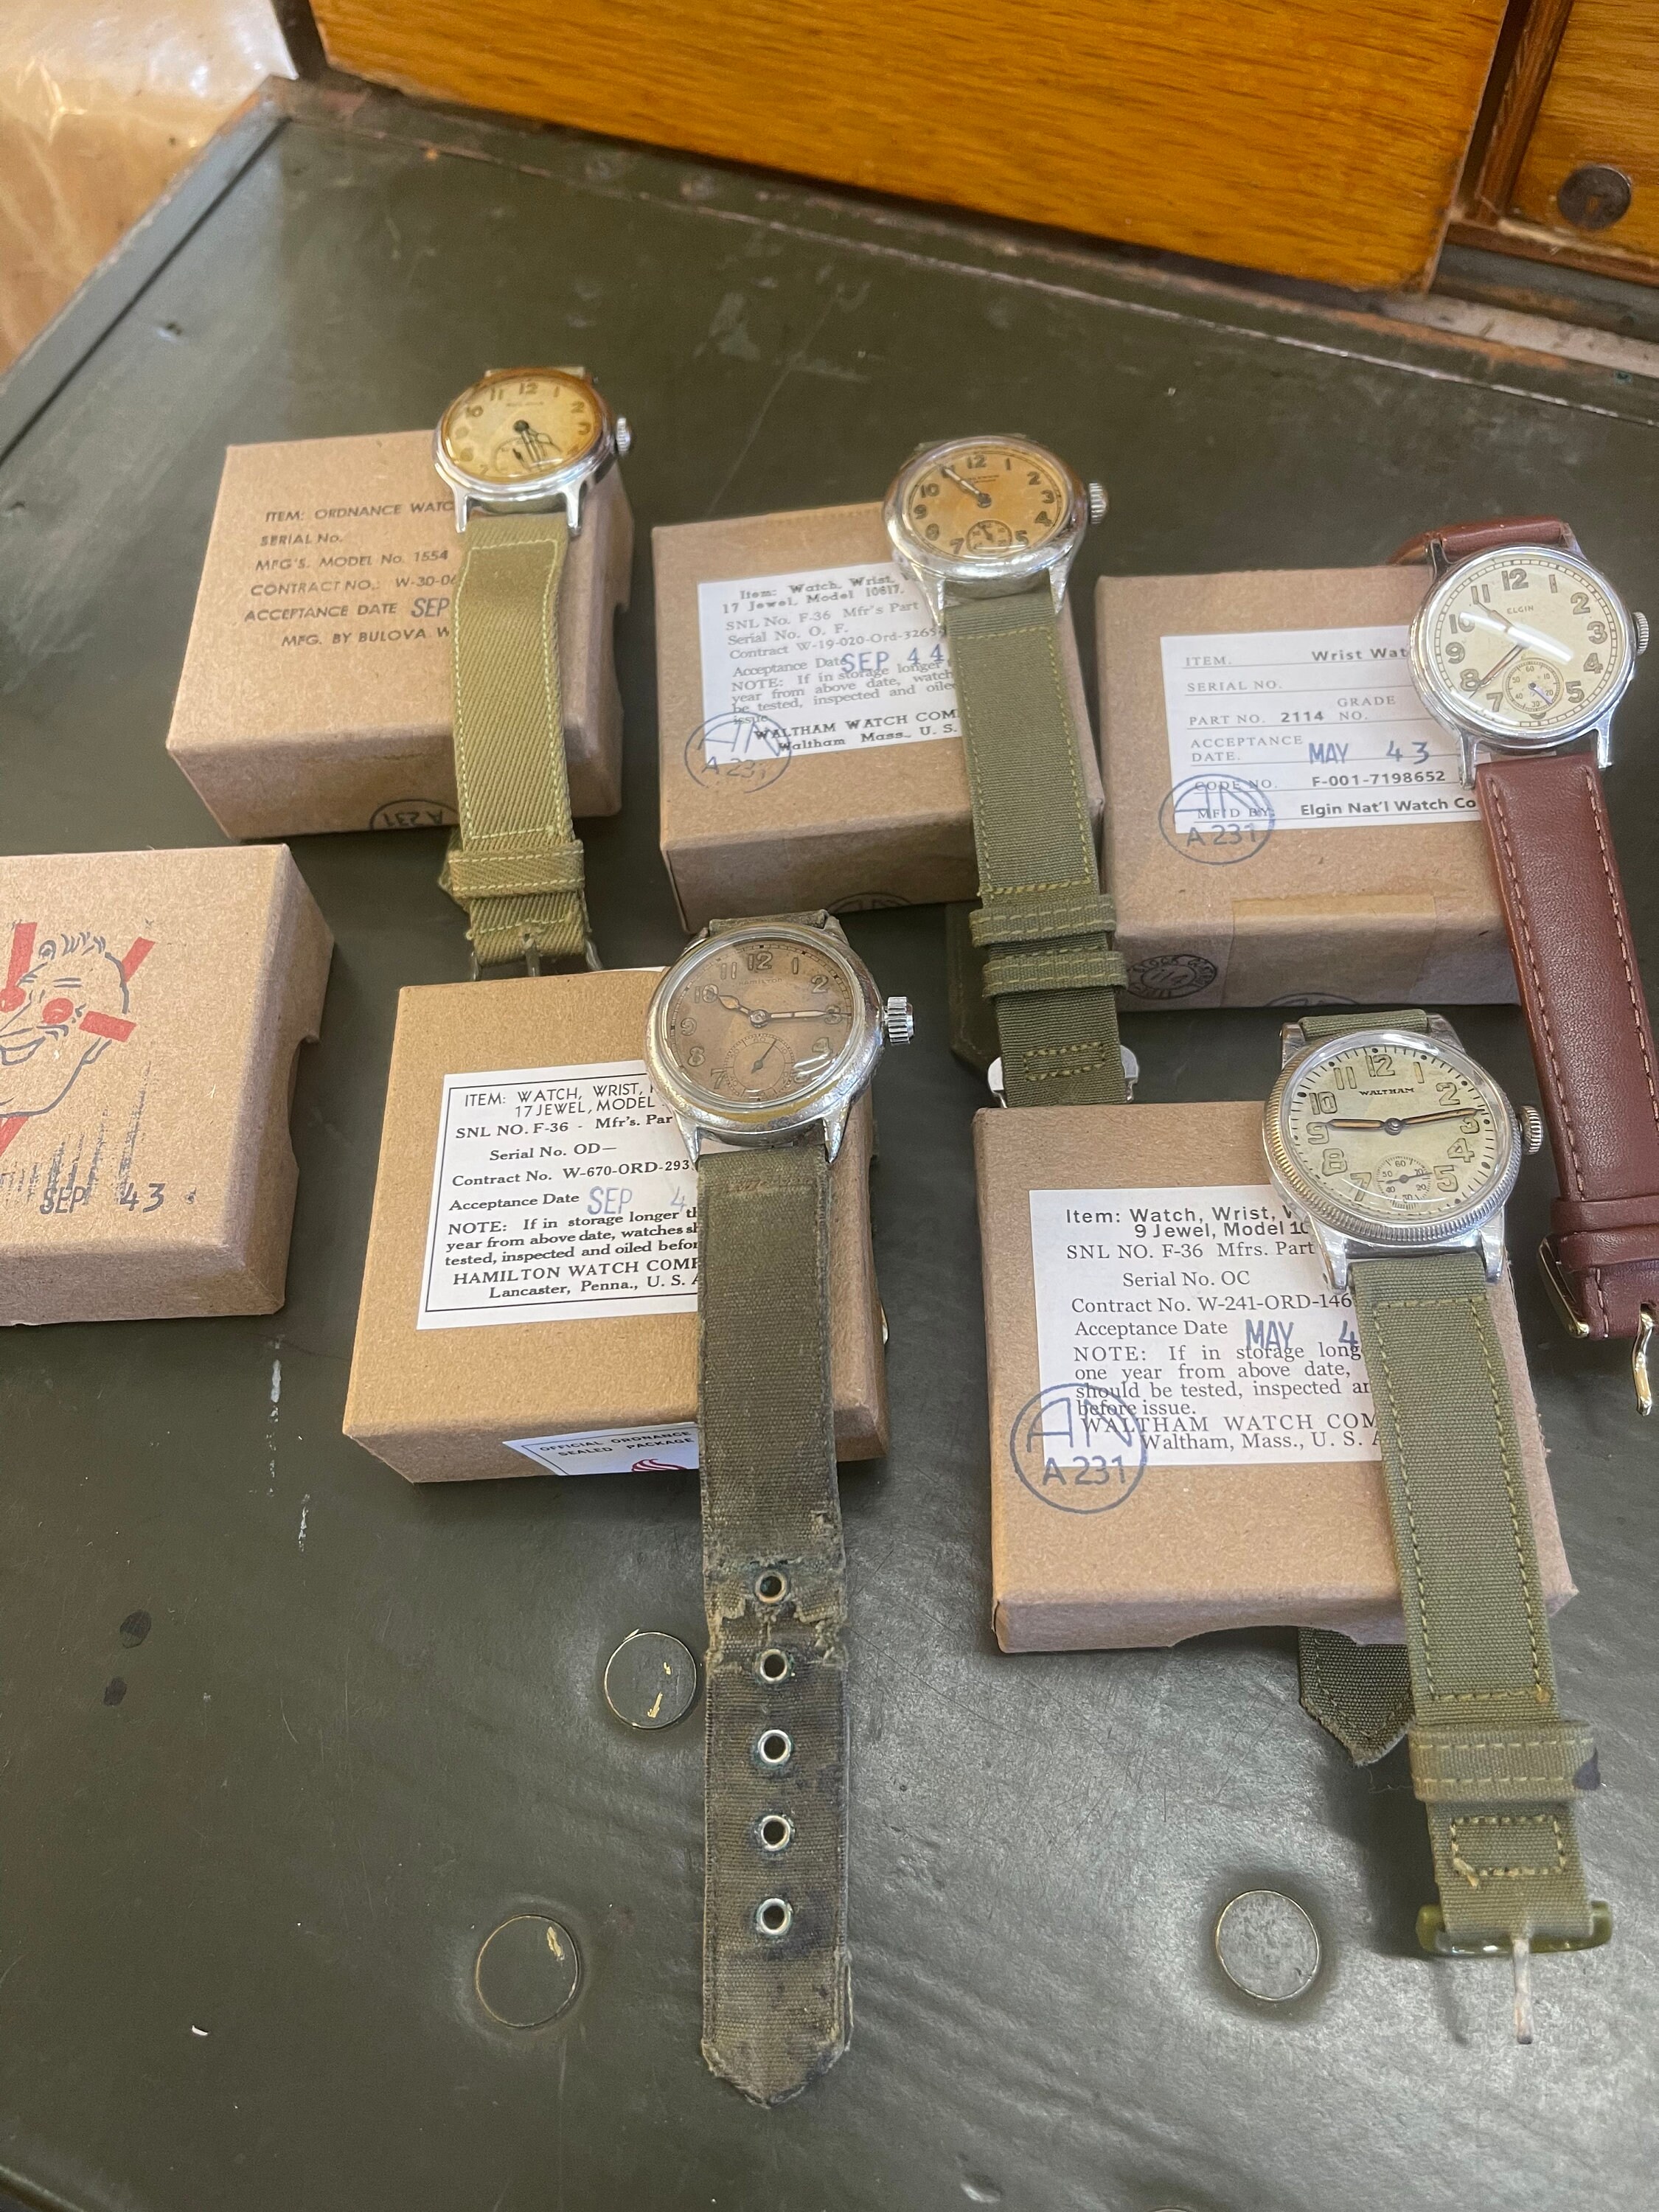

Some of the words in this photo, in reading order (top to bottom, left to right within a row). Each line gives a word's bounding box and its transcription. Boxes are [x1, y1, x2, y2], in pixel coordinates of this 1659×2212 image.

[315, 504, 402, 520] ORDNANCE
[260, 534, 311, 546] SERIAL
[319, 555, 372, 568] MODEL
[414, 550, 448, 561] 1554
[251, 581, 339, 597] CONTRACT
[1501, 568, 1529, 591] 12
[807, 590, 853, 603] Model
[1470, 583, 1490, 605] 11
[1571, 592, 1590, 615] 2
[244, 605, 348, 622] ACCEPTANCE
[358, 602, 397, 616] DATE
[411, 597, 450, 618] SEP
[726, 619, 759, 631] SNL
[799, 611, 831, 623] F-36
[843, 605, 884, 619] Mfr's
[890, 601, 919, 613] Part
[1507, 605, 1534, 614] ELGIN
[282, 634, 322, 647] MFG.
[332, 633, 352, 644] BY
[358, 629, 426, 642] BULOVA
[728, 634, 767, 646] Serial
[774, 630, 801, 641] No.
[1587, 621, 1608, 644] 3
[729, 645, 789, 660] Contract
[1186, 655, 1231, 667] ITEM.
[1312, 650, 1363, 661] Wrist
[1445, 641, 1465, 664] 9
[732, 660, 808, 678] Acceptance
[841, 650, 890, 673] SEP
[1584, 653, 1603, 674] 4
[731, 678, 783, 692] NOTE:
[838, 666, 888, 681] storage
[897, 661, 941, 675] longer
[1187, 681, 1247, 692] SERIAL
[1254, 680, 1283, 689] NO.
[1460, 669, 1479, 692] 8
[731, 693, 762, 705] year
[772, 686, 804, 699] from
[815, 681, 855, 695] above
[732, 703, 750, 714] be
[758, 698, 803, 712] tested,
[813, 689, 880, 706] inspected
[889, 686, 916, 697] and
[1338, 696, 1395, 708] GRADE
[1486, 692, 1503, 712] 7
[1565, 681, 1585, 703] 5
[754, 723, 836, 741] WALTHAM
[844, 714, 908, 730] WATCH
[1189, 714, 1229, 726] PART
[1237, 714, 1265, 724] NO.
[1280, 711, 1324, 723] 2114
[1339, 712, 1368, 720] NO.
[1191, 735, 1304, 748] ACCEPTANCE
[1192, 751, 1240, 762] DATE.
[1309, 742, 1349, 765] MAY
[1194, 781, 1240, 790] CODE
[1312, 771, 1445, 787] F-001-7198652
[1301, 804, 1342, 818] Elgin
[1348, 801, 1388, 813] Nat'l
[1394, 799, 1448, 811] Watch
[748, 952, 773, 971] 12
[1366, 1054, 1396, 1077] 12
[1333, 1066, 1357, 1090] 11
[465, 1092, 506, 1107] ITEM:
[517, 1087, 582, 1103] WATCH,
[593, 1082, 643, 1097] WRIST,
[1358, 1088, 1414, 1096] WALTHAM
[1436, 1082, 1460, 1106] 2
[515, 1106, 532, 1118] 17
[535, 1102, 593, 1117] JEWEL,
[597, 1096, 655, 1111] MODEL
[1309, 1091, 1338, 1115] 10
[455, 1127, 490, 1138] SNL
[497, 1124, 529, 1136] NO.
[533, 1122, 568, 1134] F-36
[595, 1116, 641, 1130] Mfr's.
[647, 1114, 673, 1125] Par
[1307, 1122, 1329, 1145] 9
[490, 1148, 534, 1161] Serial
[539, 1146, 566, 1158] No.
[1447, 1138, 1475, 1163] 4
[1322, 1149, 1348, 1176] 8
[452, 1173, 521, 1186] Contract
[526, 1171, 552, 1182] No.
[1350, 1172, 1372, 1201] 7
[1434, 1165, 1460, 1192] 5
[40, 1186, 88, 1214] SEP
[448, 1196, 538, 1211] Acceptance
[542, 1193, 580, 1205] Date
[587, 1185, 633, 1215] SEP
[448, 1222, 507, 1235] NOTE:
[524, 1219, 536, 1230] If
[543, 1218, 558, 1229] in
[568, 1214, 624, 1227] storage
[629, 1210, 680, 1224] longer
[1066, 1208, 1121, 1224] Item:
[1129, 1208, 1203, 1223] Watch,
[1211, 1206, 1276, 1222] Wrist,
[445, 1240, 482, 1253] year
[487, 1237, 524, 1248] from
[529, 1233, 576, 1245] above
[579, 1230, 616, 1242] date,
[621, 1224, 683, 1238] watches
[1134, 1225, 1147, 1239] 9
[1152, 1222, 1216, 1239] Jewel,
[1223, 1221, 1284, 1237] Model
[445, 1253, 498, 1266] tested,
[501, 1247, 575, 1264] inspected
[581, 1244, 611, 1256] and
[615, 1241, 653, 1253] oiled
[1067, 1245, 1110, 1259] SNL
[1117, 1244, 1154, 1259] NO.
[1162, 1243, 1203, 1258] F-36
[1217, 1242, 1268, 1256] Mfrs.
[1276, 1241, 1315, 1255] Part
[453, 1266, 560, 1285] HAMILTON
[568, 1261, 639, 1277] WATCH
[1123, 1272, 1175, 1287] Serial
[1181, 1271, 1215, 1287] No.
[1220, 1270, 1251, 1285] OC
[489, 1285, 571, 1299] Lancaster,
[581, 1280, 638, 1293] Penna.,
[1071, 1298, 1152, 1312] Contract
[1158, 1297, 1191, 1312] No.
[1197, 1293, 1352, 1312] W-241-ORD-146
[1074, 1321, 1178, 1342] Acceptance
[1183, 1320, 1228, 1335] Date
[1245, 1320, 1293, 1350] MAY
[1074, 1346, 1147, 1362] NOTE:
[1169, 1346, 1186, 1361] If
[1202, 1346, 1220, 1360] in
[1237, 1346, 1304, 1362] storage
[1074, 1366, 1107, 1380] one
[1121, 1367, 1162, 1382] year
[1178, 1364, 1225, 1379] from
[1238, 1362, 1290, 1377] above
[1304, 1362, 1350, 1378] date,
[1077, 1382, 1140, 1399] should
[1150, 1382, 1172, 1398] be
[1181, 1382, 1242, 1399] tested,
[1253, 1380, 1341, 1399] inspected
[1078, 1399, 1137, 1416] before
[1142, 1399, 1196, 1415] issue.
[1081, 1416, 1209, 1433] WALTHAM
[1224, 1415, 1314, 1431] WATCH
[540, 1441, 604, 1452] OFFICIAL
[611, 1431, 692, 1444] ORDNANCE
[558, 1447, 613, 1456] SEALED
[626, 1438, 695, 1450] PACKAGE
[1140, 1434, 1234, 1451] Waltham,
[1242, 1433, 1304, 1449] Mass.,
[1073, 1455, 1126, 1485] 231
